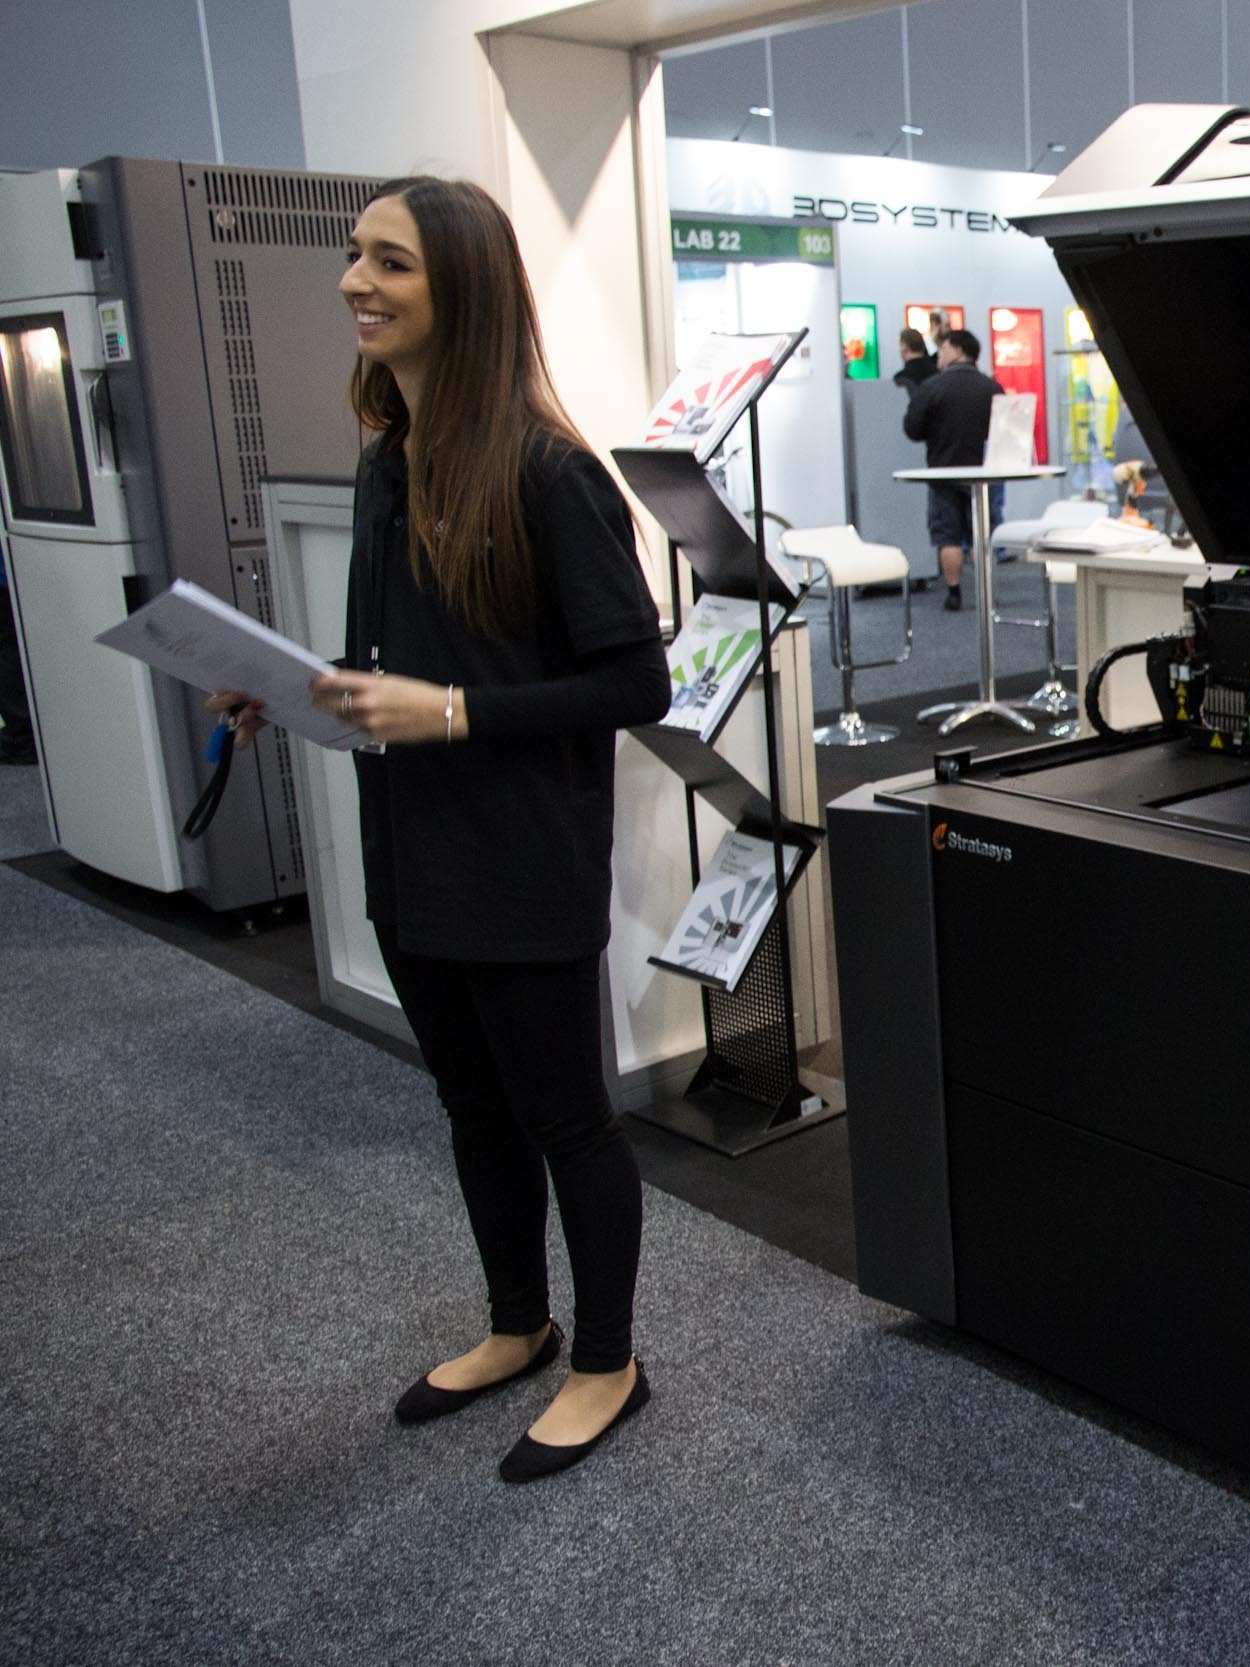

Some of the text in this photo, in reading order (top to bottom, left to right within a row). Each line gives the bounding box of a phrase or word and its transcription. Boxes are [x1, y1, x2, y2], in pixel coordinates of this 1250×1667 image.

[672, 228, 741, 251] LAB 22
[947, 831, 1012, 862] Stratasys
